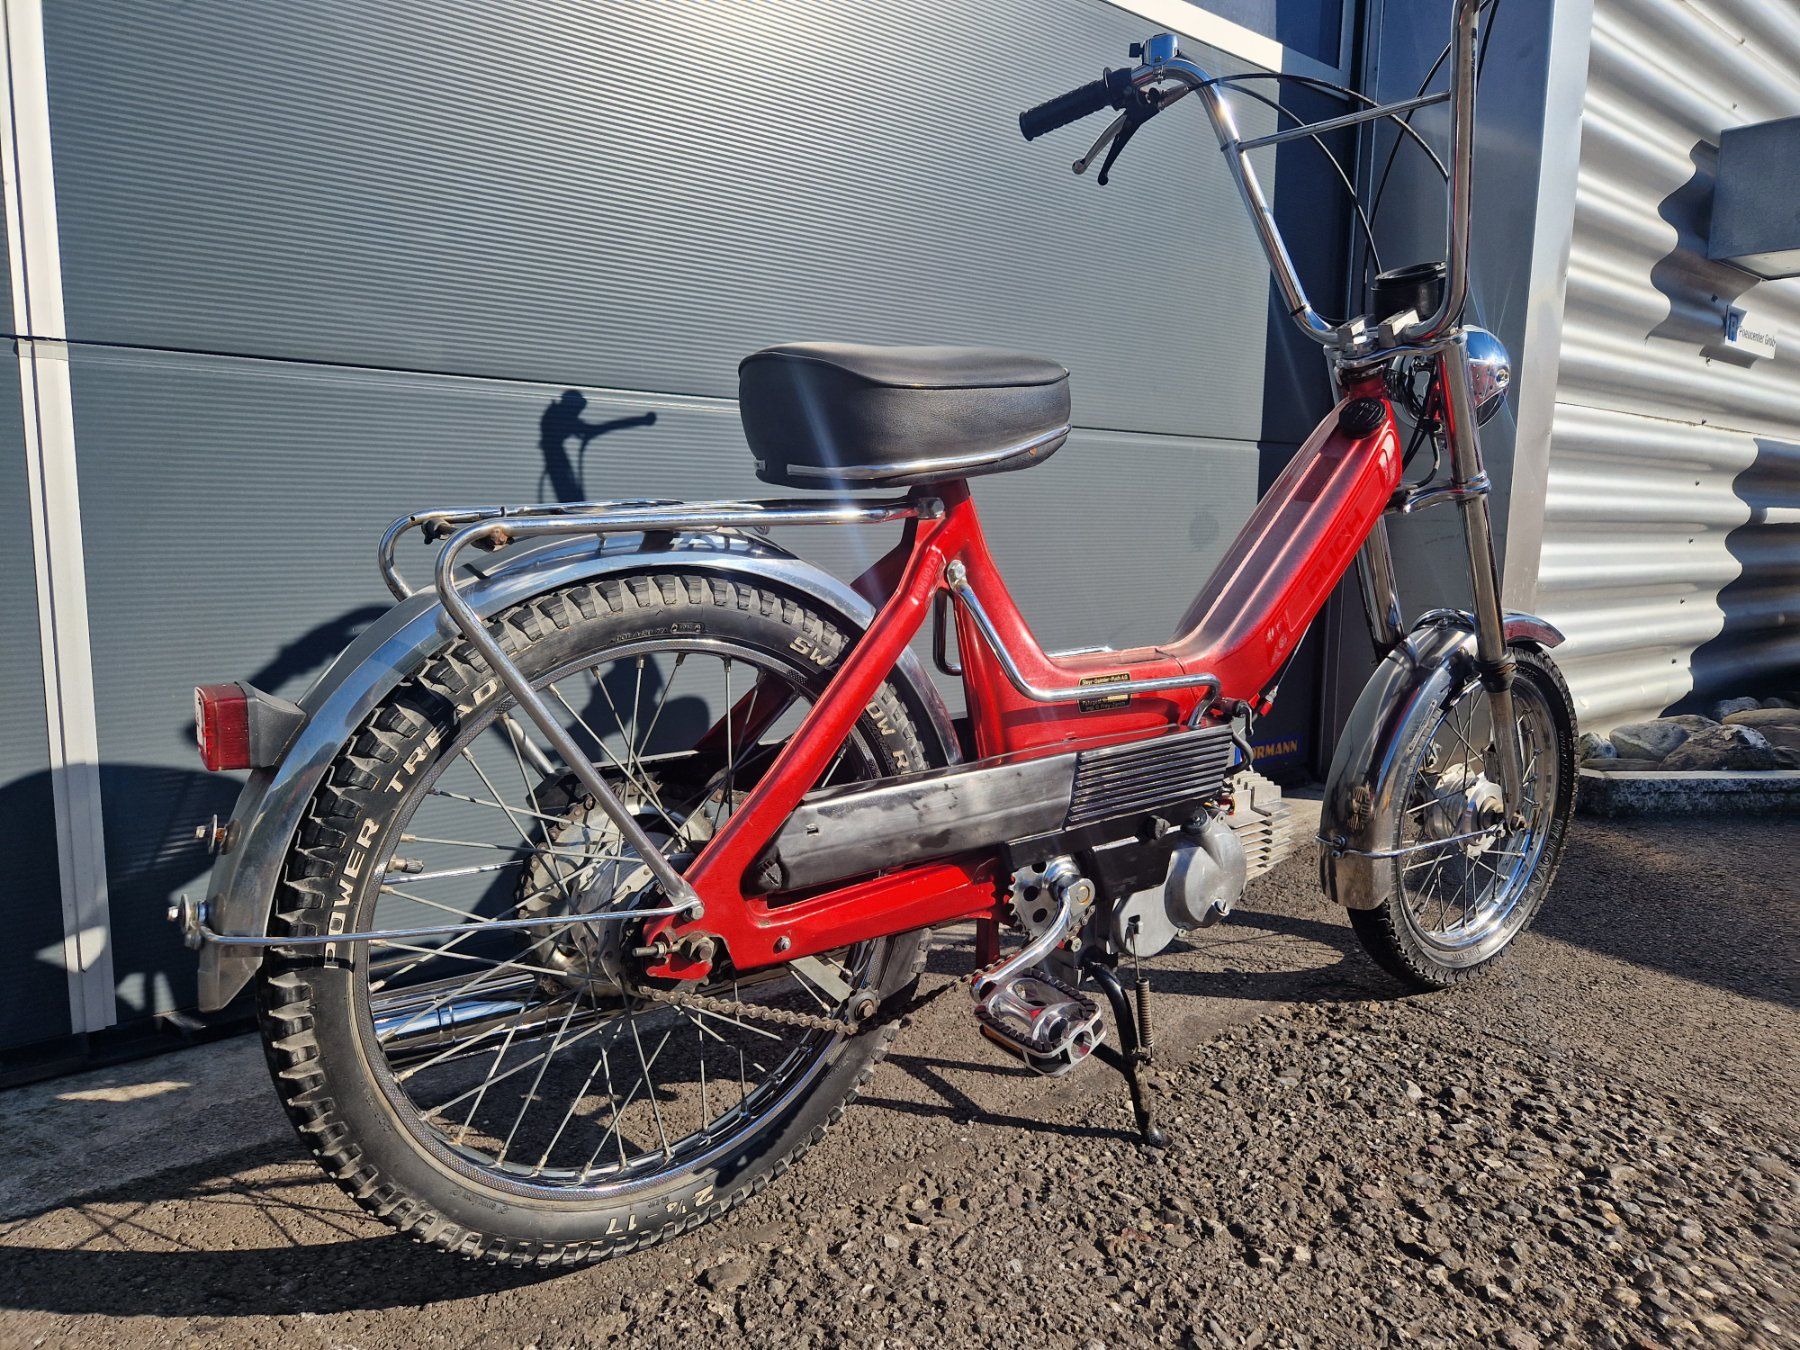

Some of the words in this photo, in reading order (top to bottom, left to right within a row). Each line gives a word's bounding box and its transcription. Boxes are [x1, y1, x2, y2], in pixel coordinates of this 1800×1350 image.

[1252, 740, 1298, 760] ORMANN
[1532, 818, 1565, 886] MALOYA
[324, 817, 381, 969] POWER
